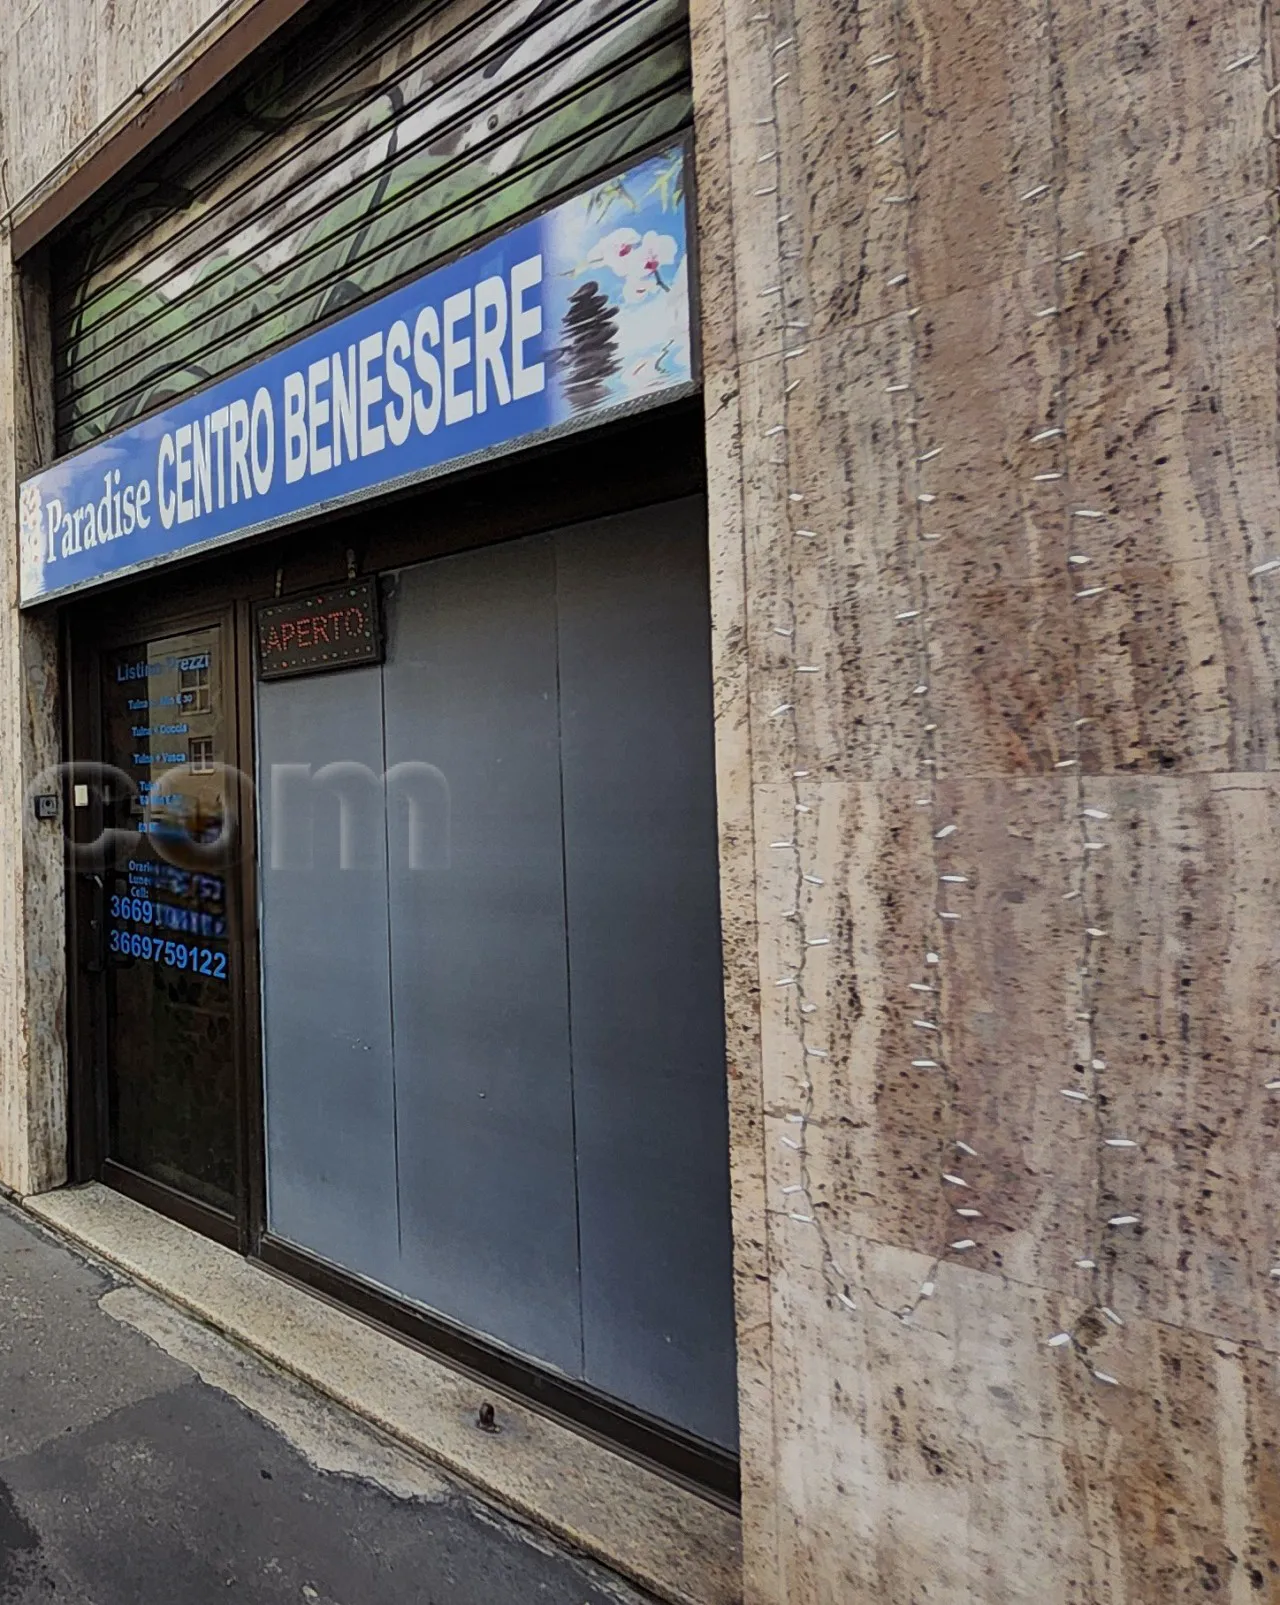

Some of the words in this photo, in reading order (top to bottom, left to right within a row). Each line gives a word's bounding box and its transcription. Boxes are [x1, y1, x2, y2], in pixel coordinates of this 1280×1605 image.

[45, 465, 152, 564] Paradise
[156, 385, 276, 531] CENTRO
[282, 252, 547, 488] BENESSERE
[266, 607, 364, 654] APERTO
[110, 929, 226, 979] 3669759122
